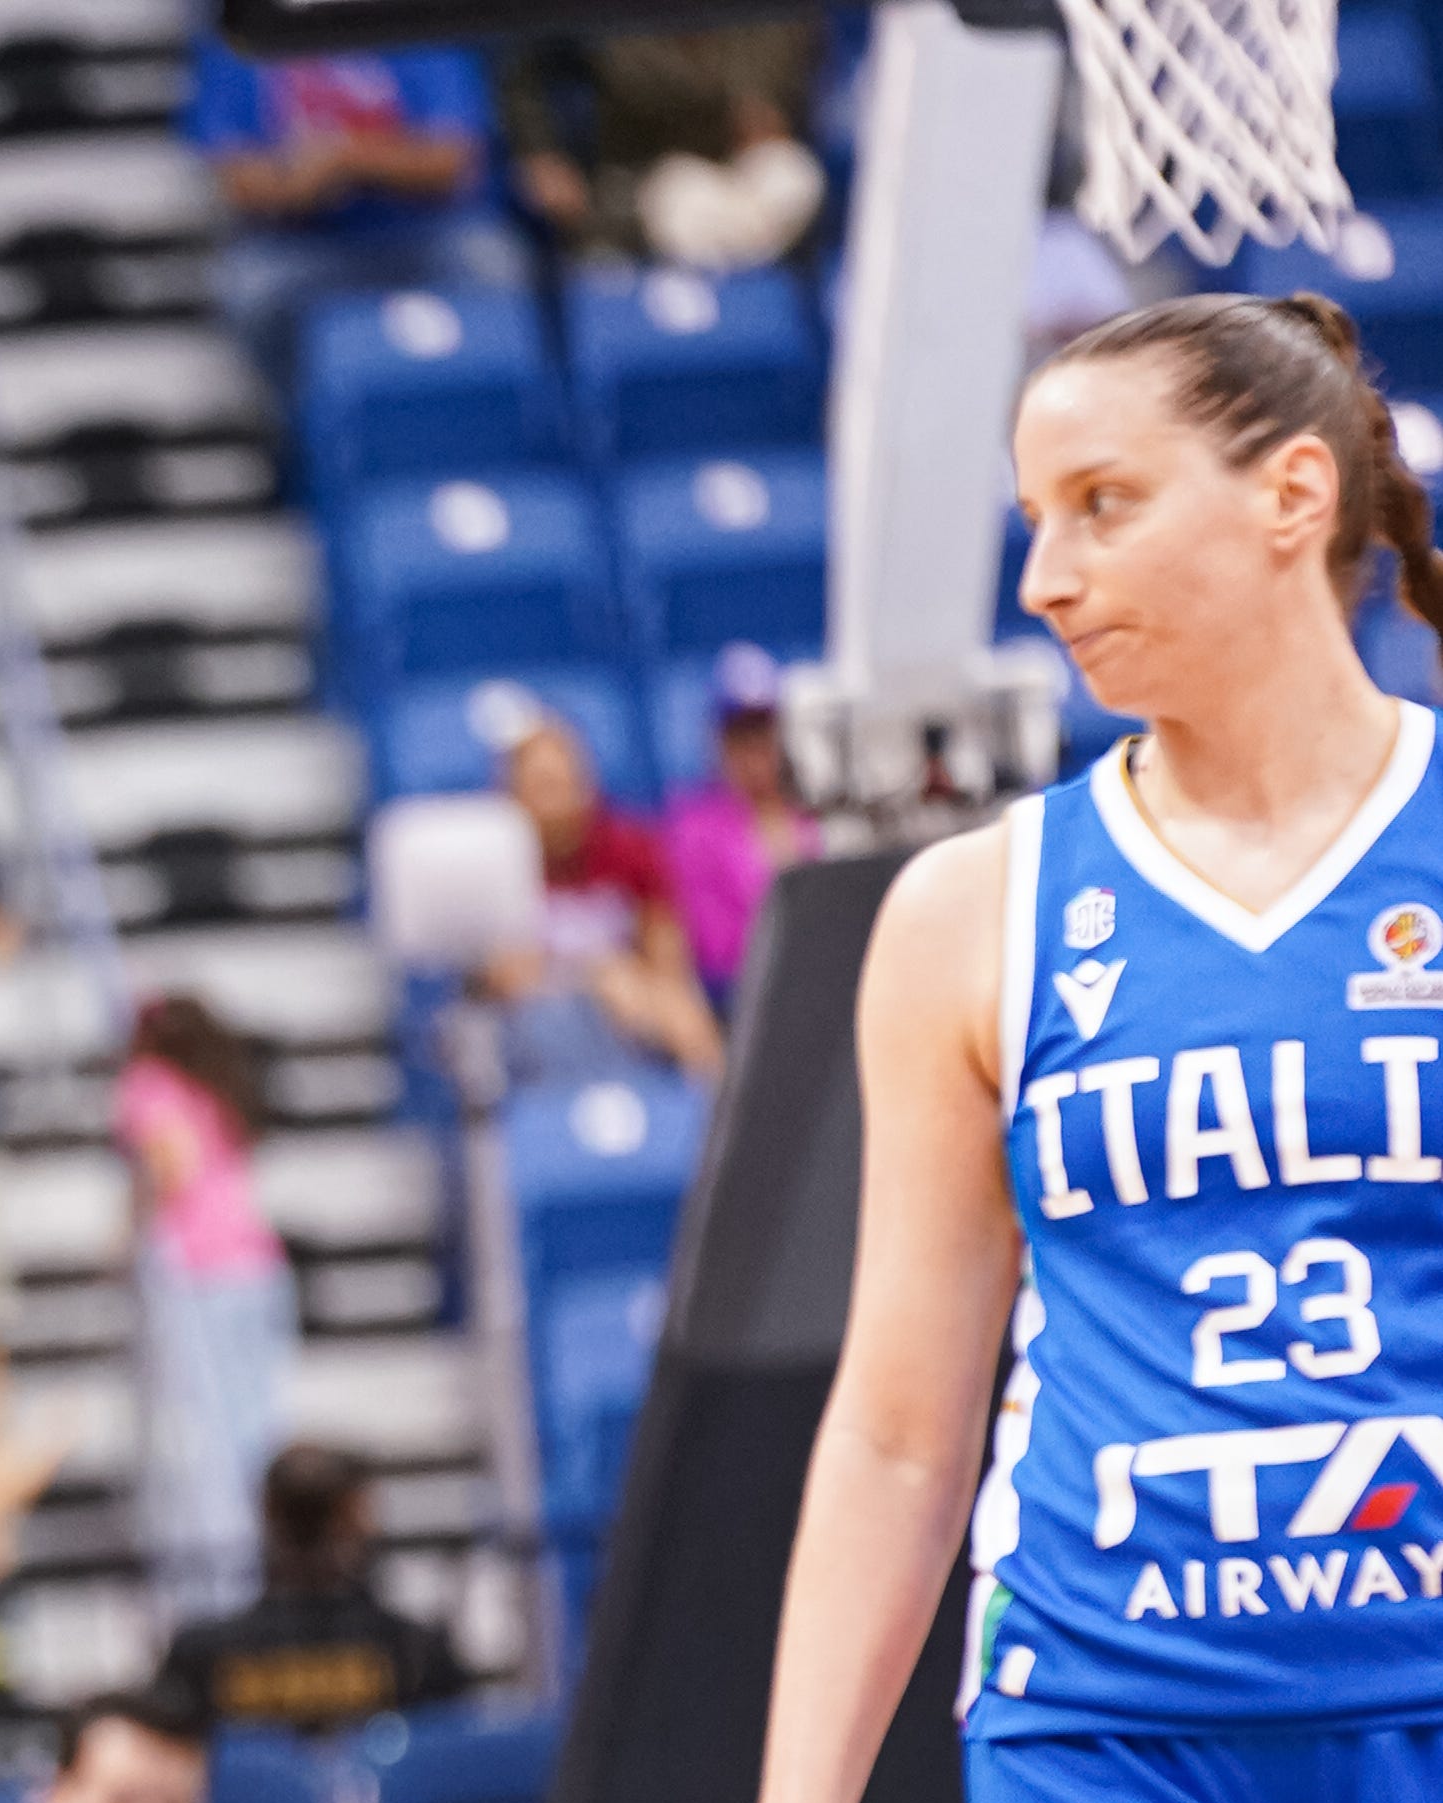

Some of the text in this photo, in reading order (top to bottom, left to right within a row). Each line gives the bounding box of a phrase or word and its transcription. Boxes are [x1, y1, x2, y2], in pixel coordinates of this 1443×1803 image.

[1024, 1035, 1443, 1220] ITALI
[1180, 1238, 1382, 1388] 23
[1124, 1542, 1443, 1622] AIRWAY
